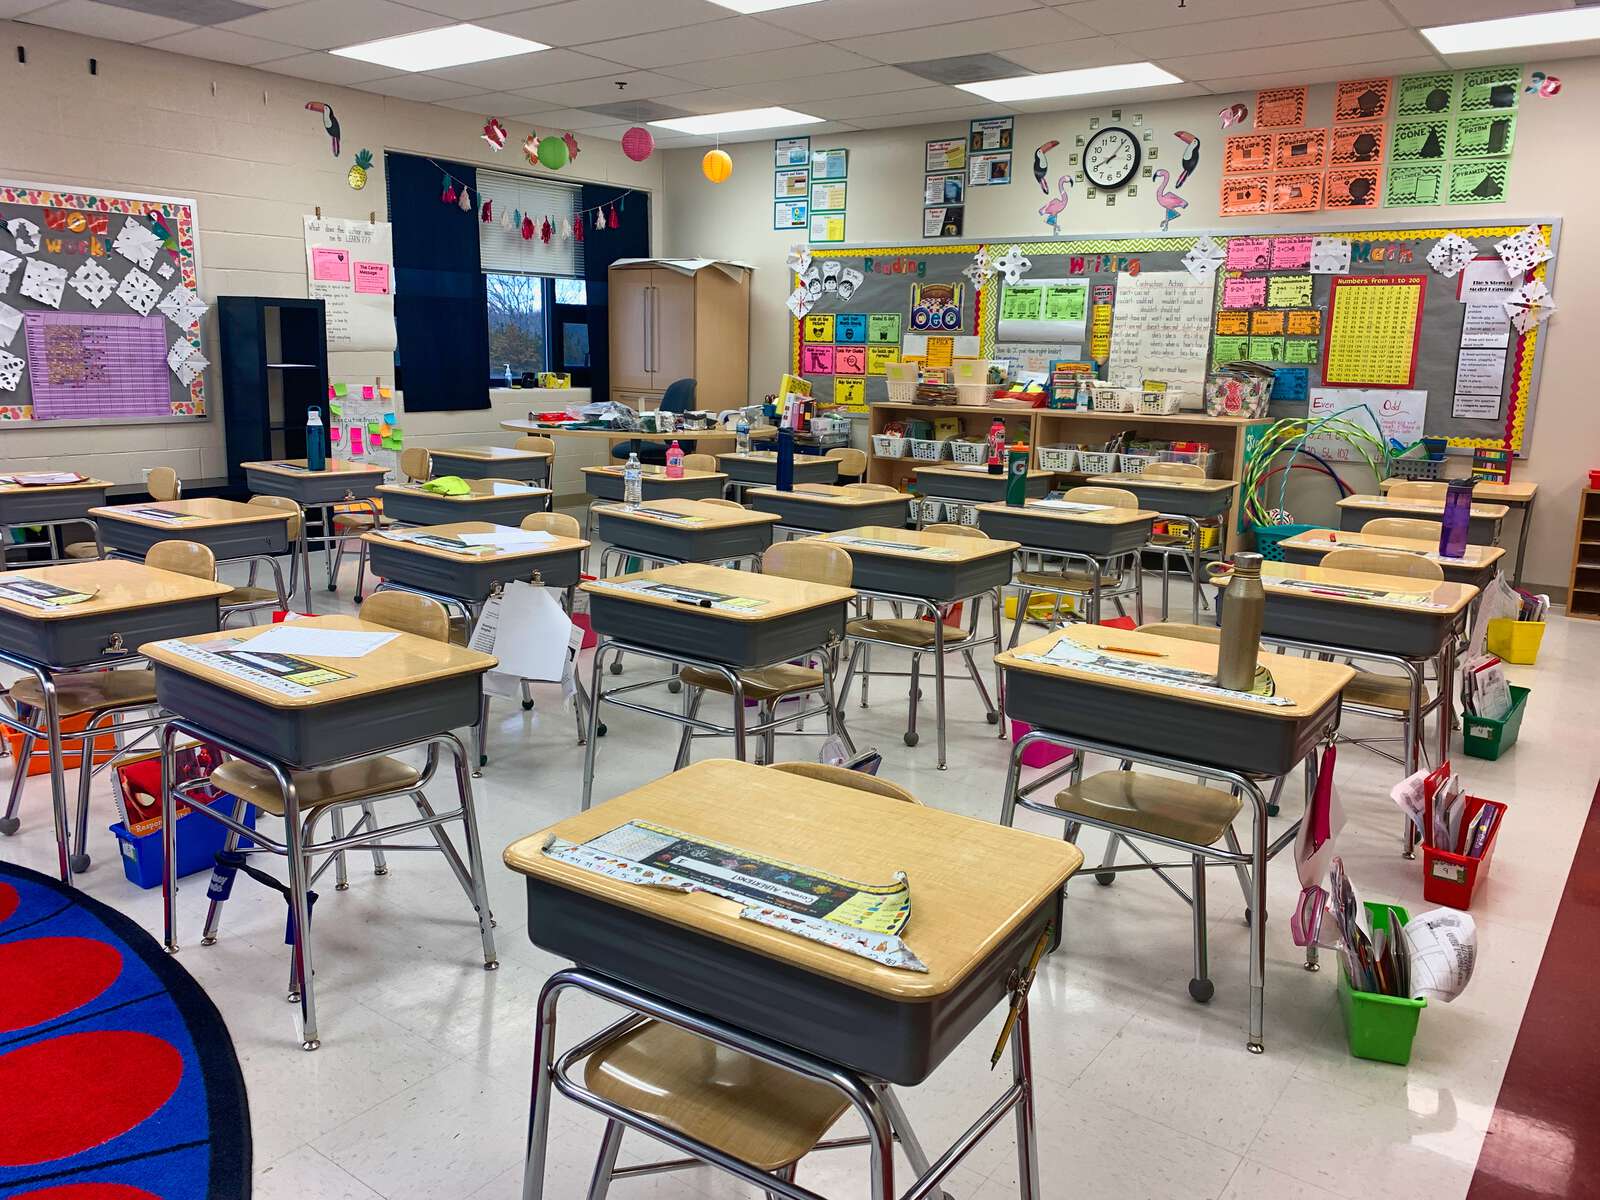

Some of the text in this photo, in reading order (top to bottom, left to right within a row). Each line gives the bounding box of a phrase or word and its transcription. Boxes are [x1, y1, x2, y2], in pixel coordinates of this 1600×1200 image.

[1405, 81, 1431, 92] SPHERE
[1468, 75, 1496, 87] CUBE
[1400, 128, 1426, 140] CONE
[1464, 125, 1488, 134] PRISM
[1109, 135, 1118, 143] 12
[1235, 142, 1260, 151] Square
[1456, 168, 1485, 177] PYRAMID
[43, 208, 109, 235] WOW
[1351, 242, 1414, 263] Math
[864, 257, 926, 278] Reading
[1069, 256, 1141, 276] Writing
[1313, 397, 1401, 411] Even Odd
